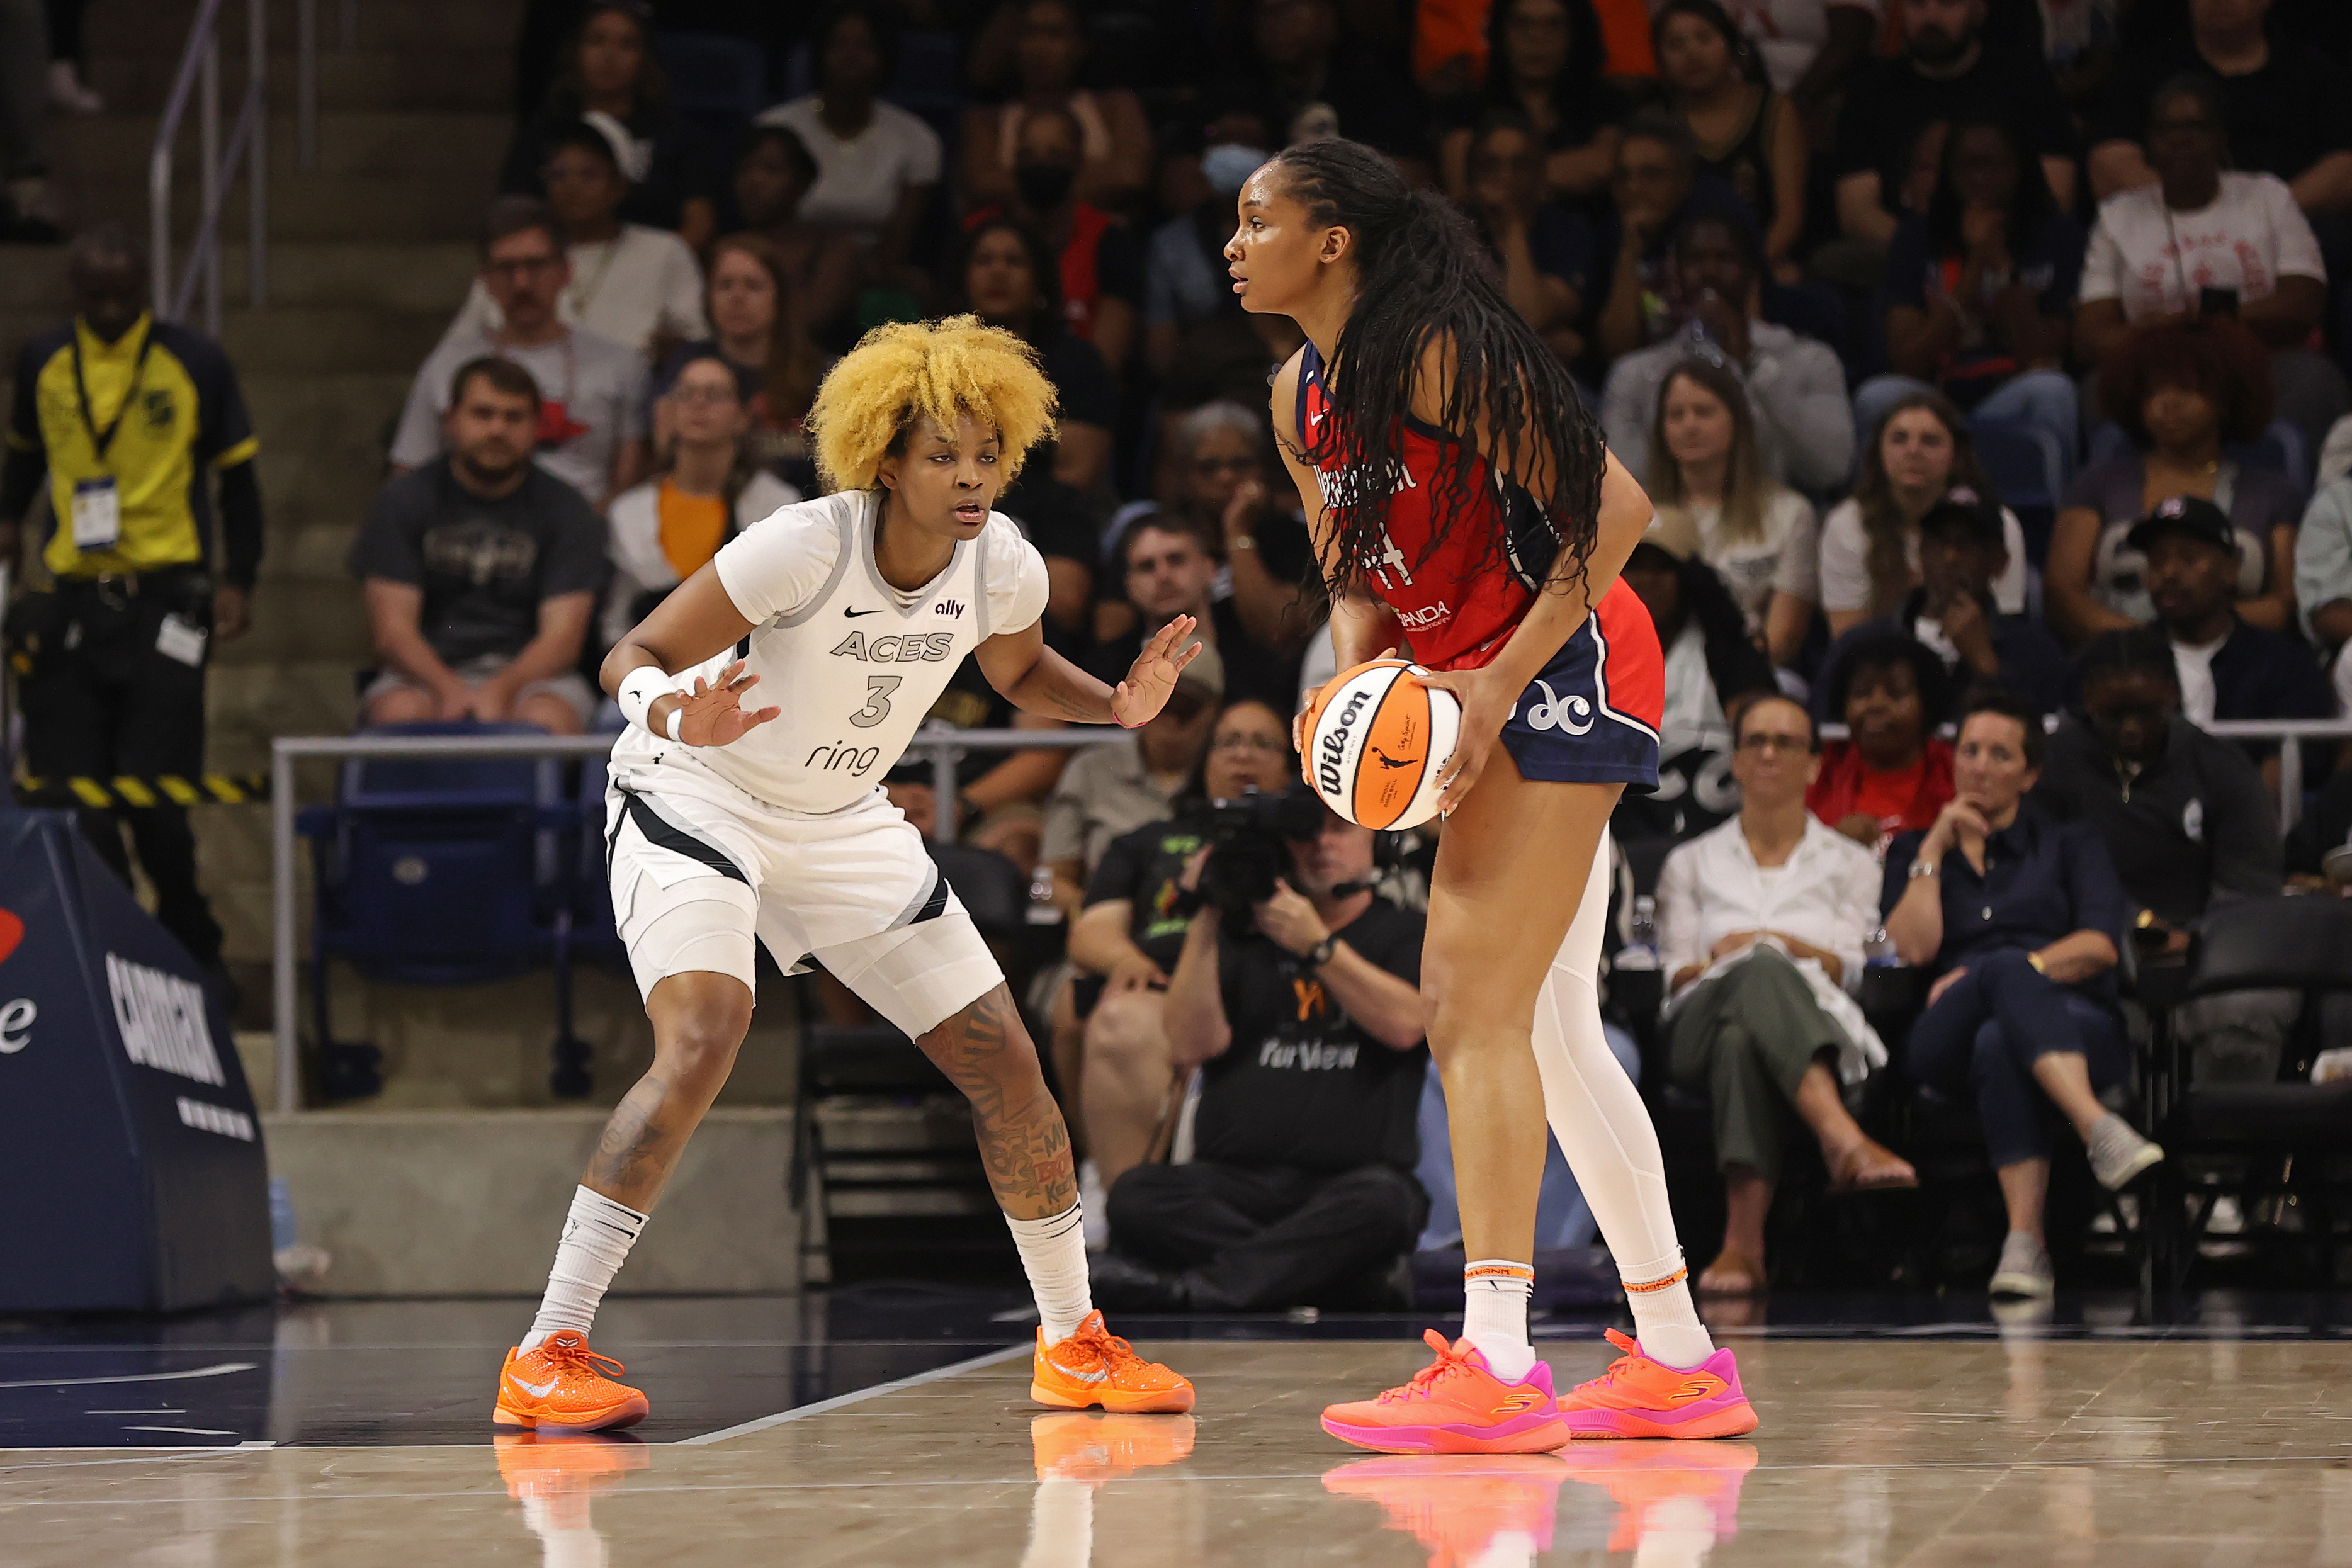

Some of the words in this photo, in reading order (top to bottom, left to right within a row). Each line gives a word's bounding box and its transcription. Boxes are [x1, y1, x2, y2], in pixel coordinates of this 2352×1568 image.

[935, 599, 965, 619] ally
[829, 631, 954, 663] ACES
[849, 675, 903, 728] 3
[805, 740, 879, 777] ring
[1320, 691, 1374, 796] Wilson
